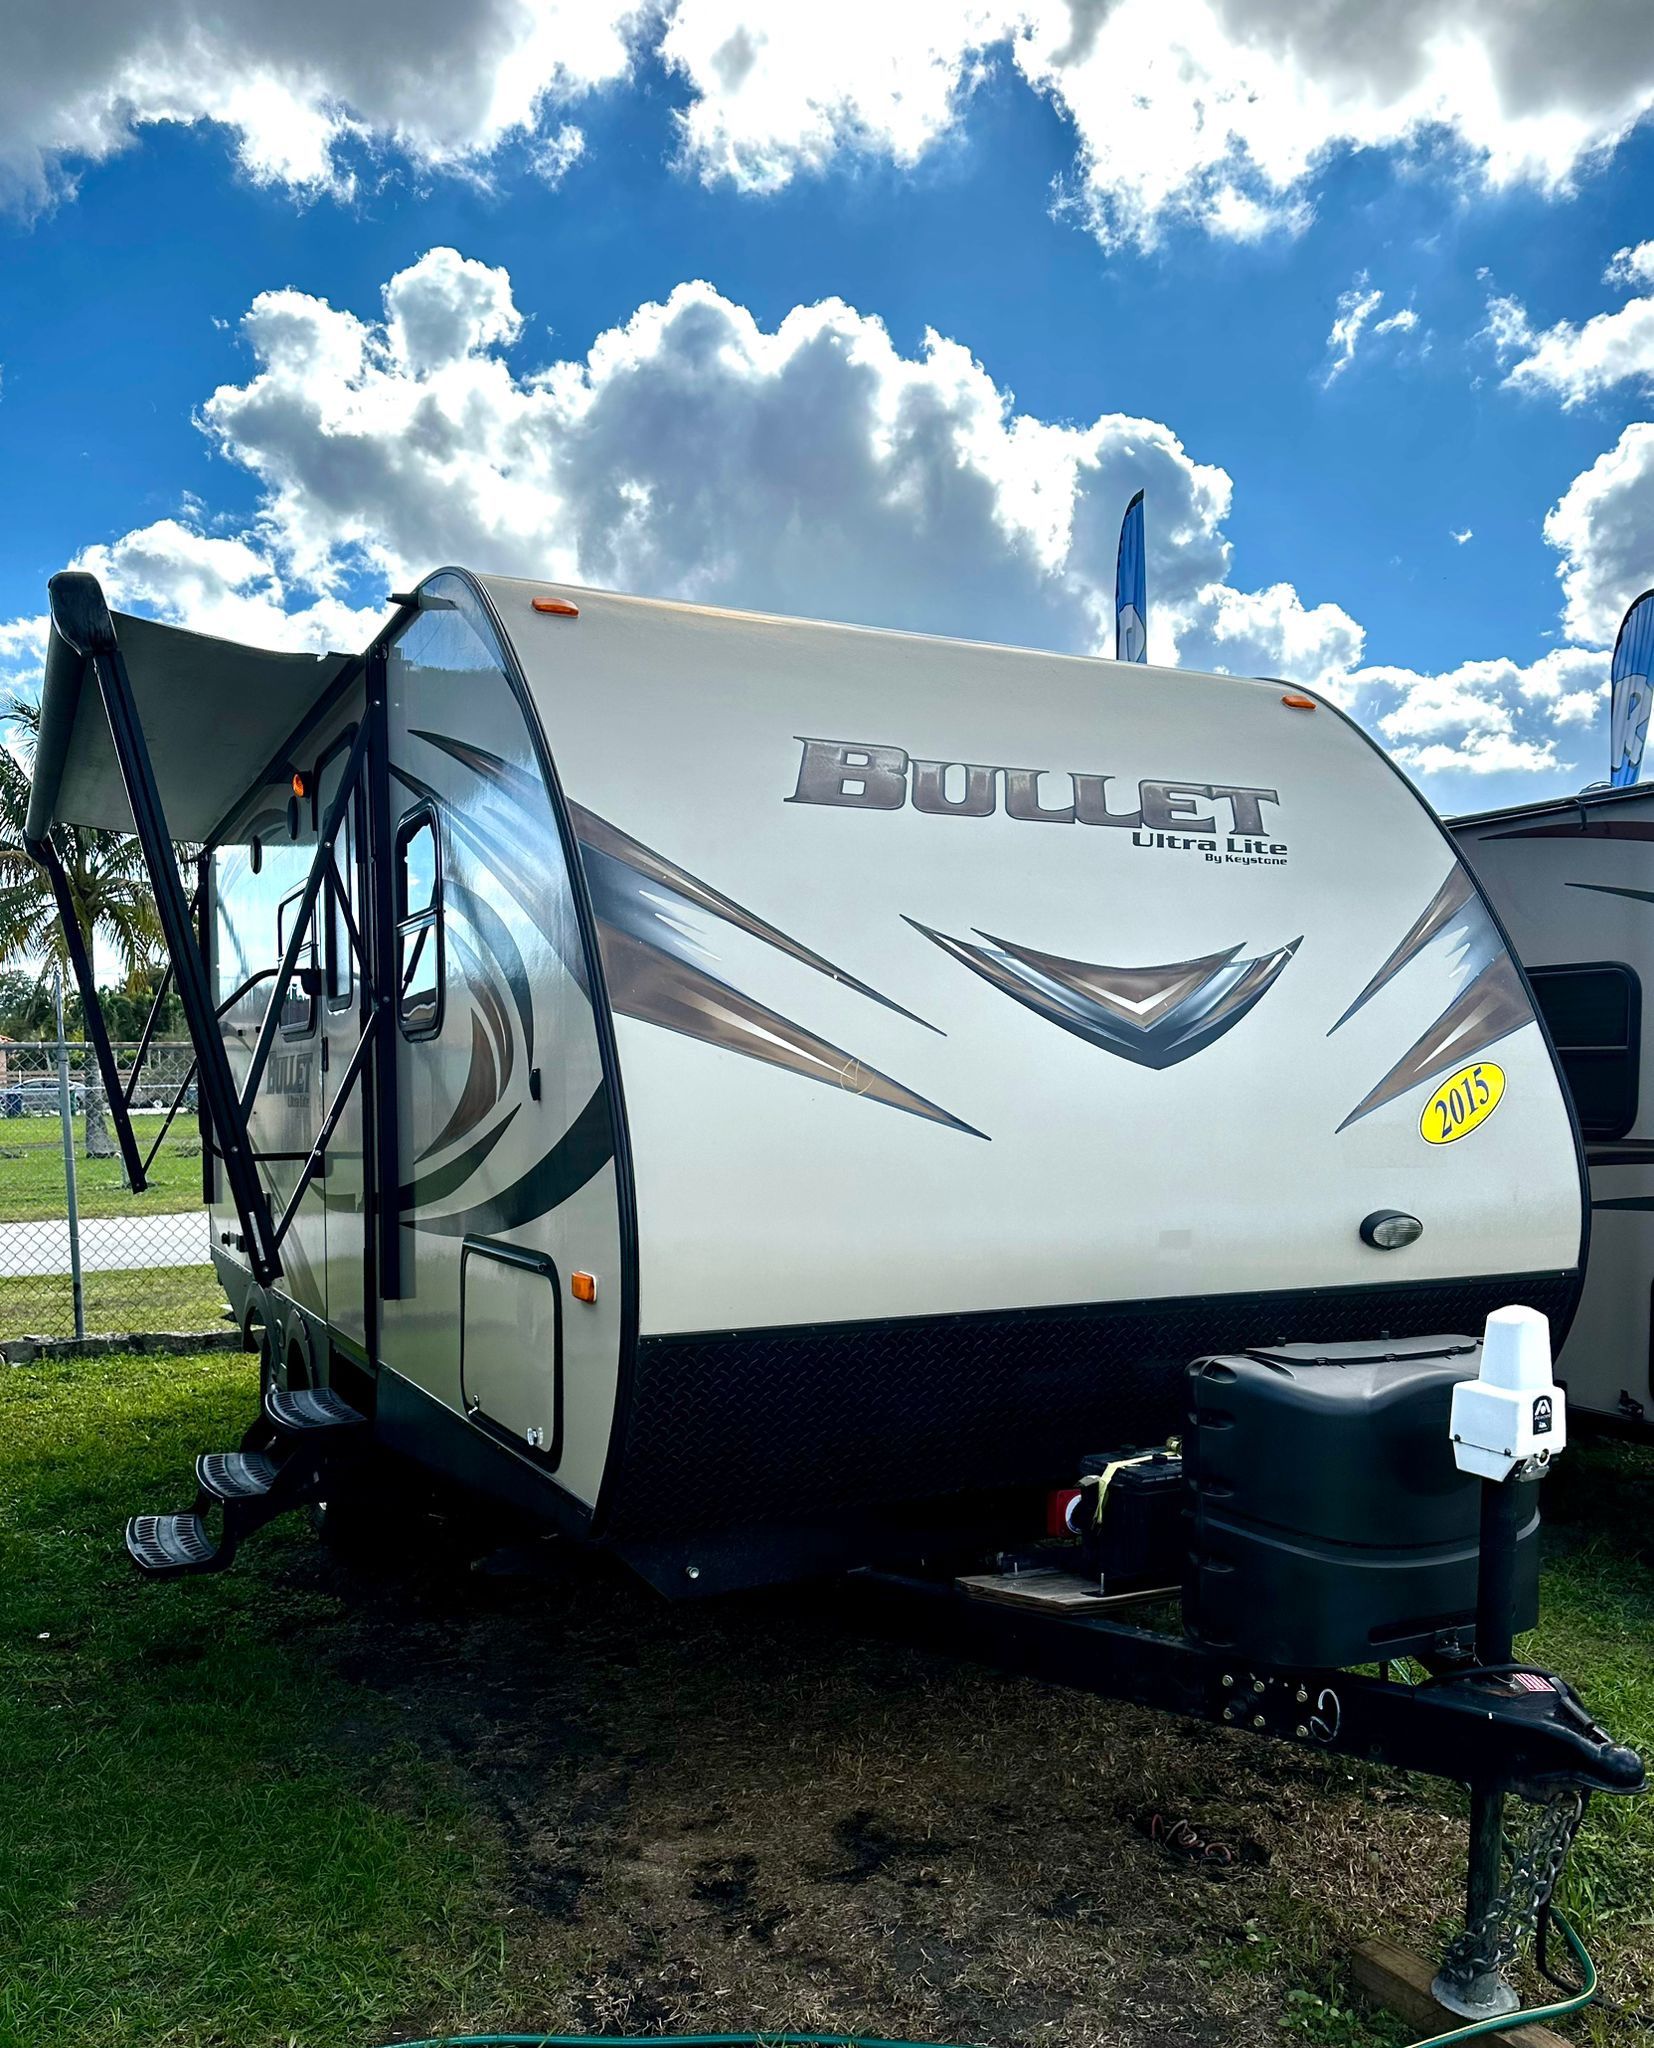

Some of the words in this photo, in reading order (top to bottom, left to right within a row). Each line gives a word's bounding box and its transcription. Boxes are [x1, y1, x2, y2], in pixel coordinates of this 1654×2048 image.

[784, 736, 1280, 836] BULLET
[1133, 832, 1216, 851] Ultra
[1227, 838, 1288, 855] Lite
[1205, 853, 1222, 864] By
[1225, 855, 1288, 866] Keystone
[1435, 1066, 1489, 1138] 2015
